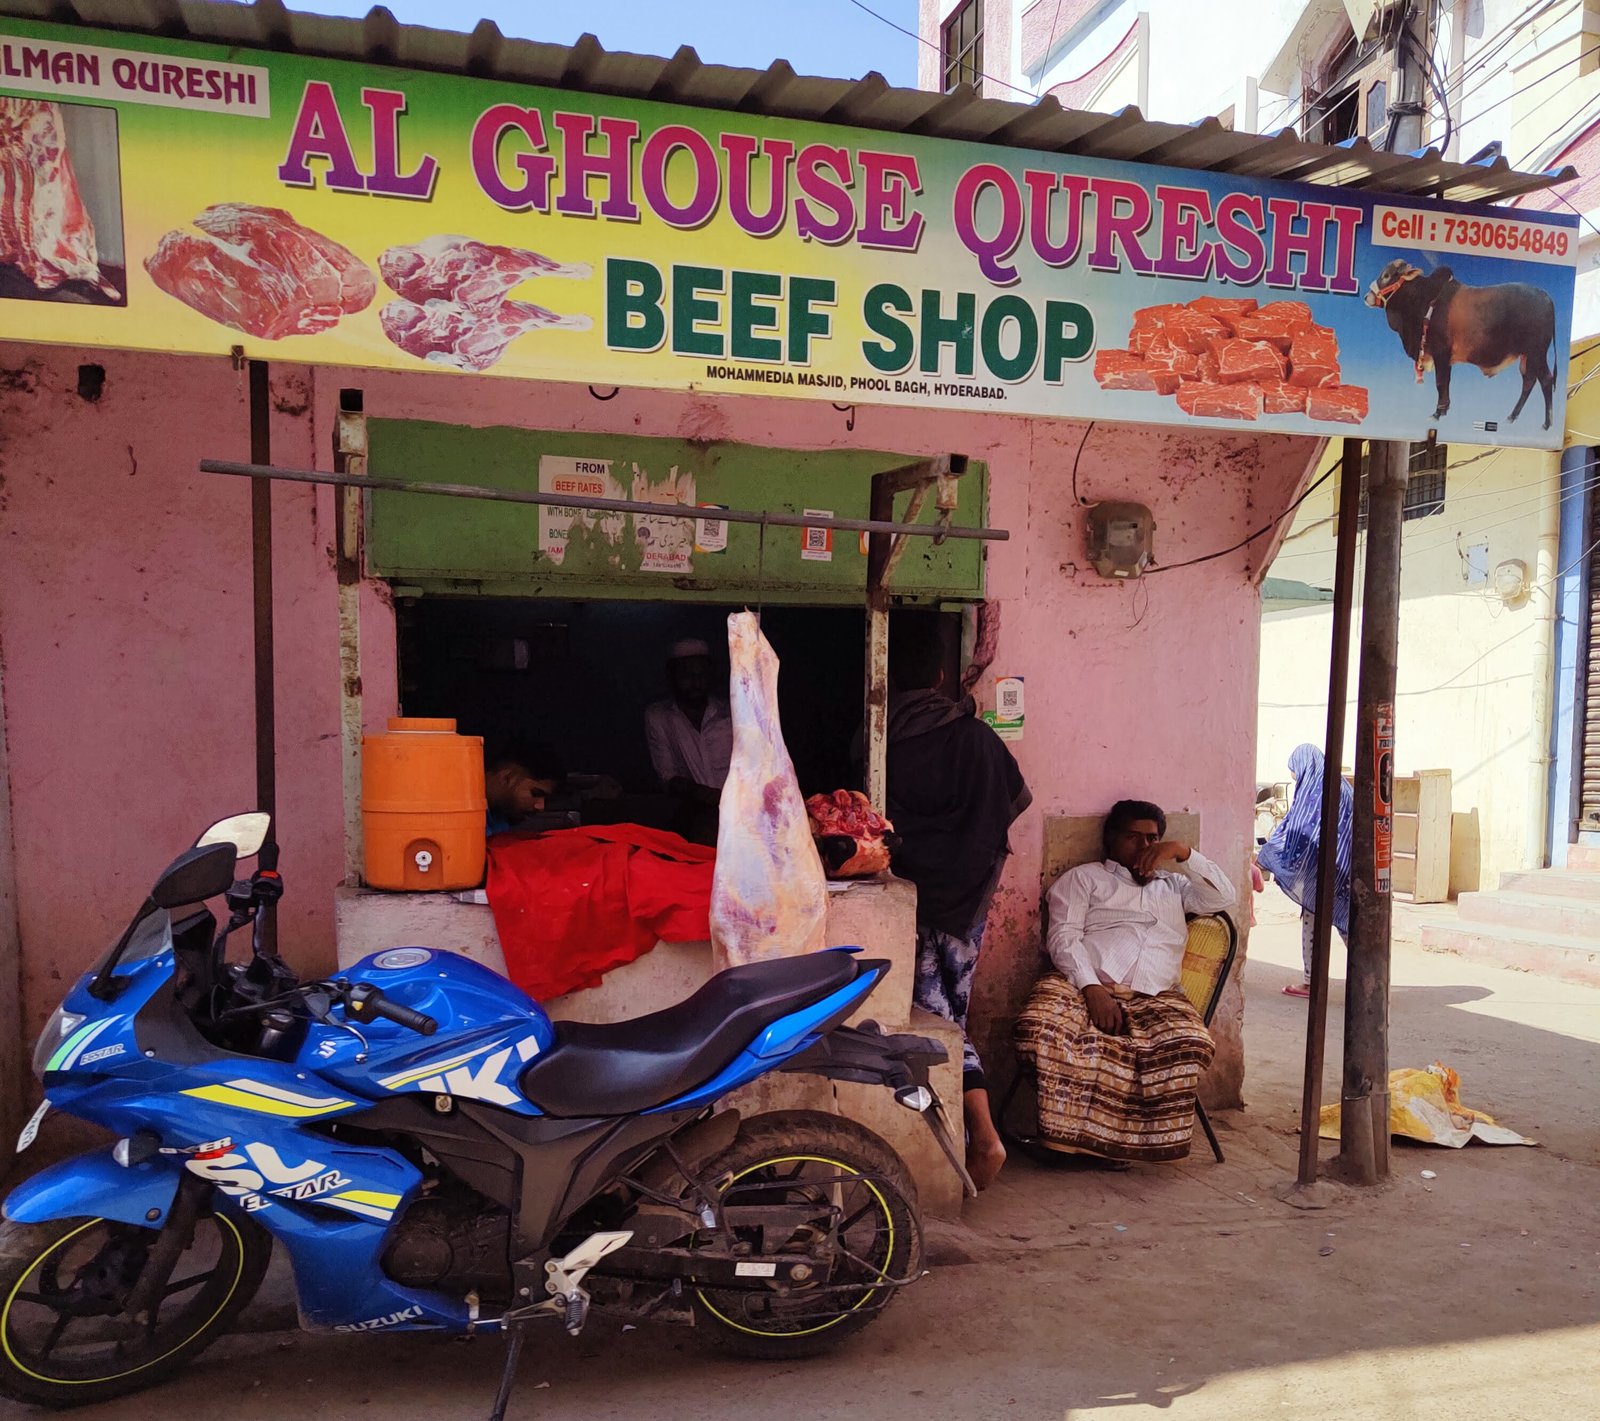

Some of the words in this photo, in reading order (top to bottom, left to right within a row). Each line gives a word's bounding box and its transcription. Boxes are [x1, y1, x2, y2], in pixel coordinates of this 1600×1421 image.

[0, 44, 100, 86] LMAN
[112, 58, 256, 105] QURESHI
[278, 81, 438, 200] AL
[471, 103, 925, 249] GHOUSE
[953, 163, 1364, 294] QURESHI
[1381, 210, 1424, 240] Cell
[1444, 218, 1568, 256] 7330654849
[605, 258, 838, 365] BEEF
[862, 283, 1096, 385] SHOP
[706, 366, 794, 384] MOHAMMEDIA
[798, 374, 846, 390] MASJID,
[850, 377, 891, 392] PHOOL
[895, 380, 930, 396] BAGH,
[934, 383, 1007, 400] HYDERABAD.
[575, 462, 605, 474] FROM
[555, 480, 577, 492] BEEF
[578, 482, 603, 494] RATES
[547, 507, 564, 517] WITH
[646, 552, 686, 561] DERABAD
[334, 1305, 424, 1333] SUZUKI
